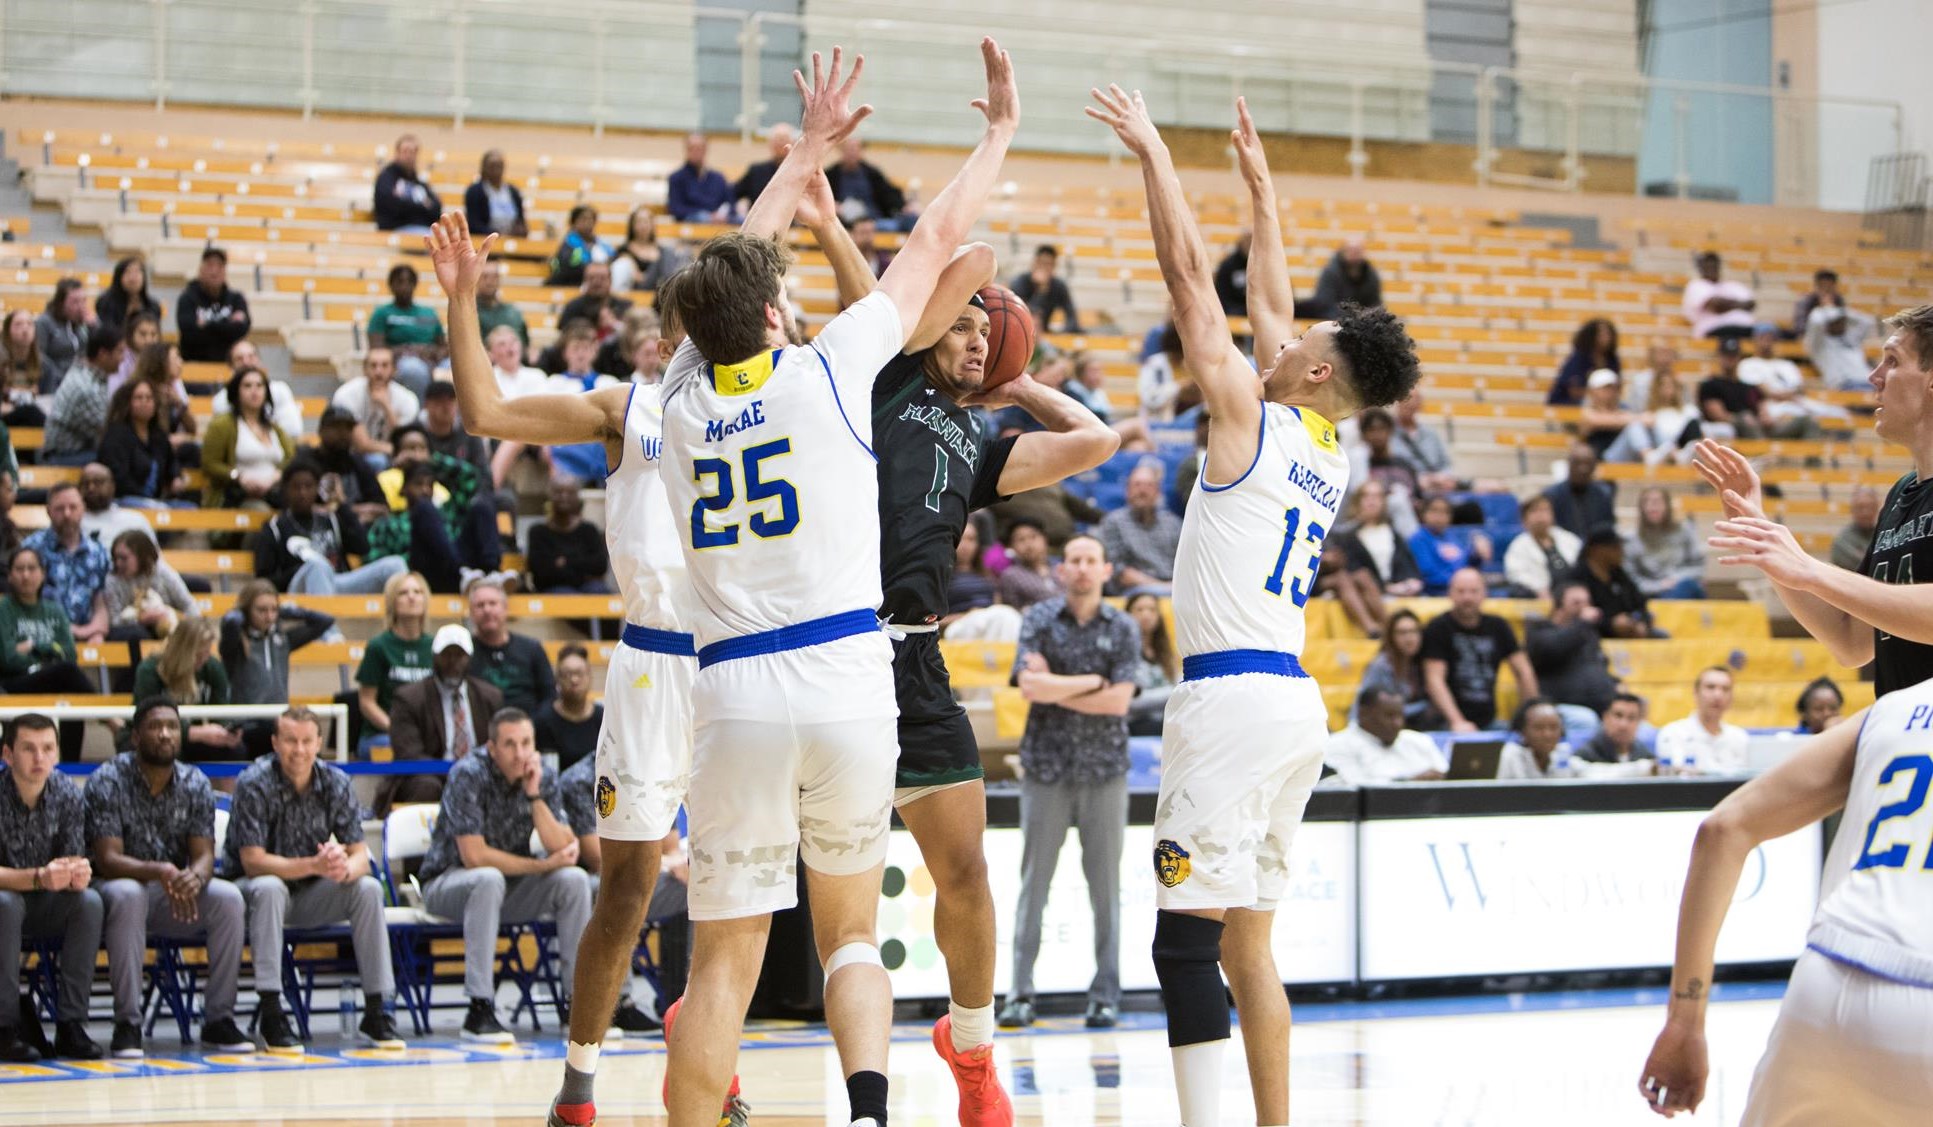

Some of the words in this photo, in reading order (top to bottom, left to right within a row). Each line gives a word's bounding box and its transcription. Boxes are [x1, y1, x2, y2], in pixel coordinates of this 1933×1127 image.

[690, 437, 801, 550] 25
[925, 442, 949, 513] 1
[1264, 506, 1326, 610] 13
[1851, 754, 1933, 871] 2
